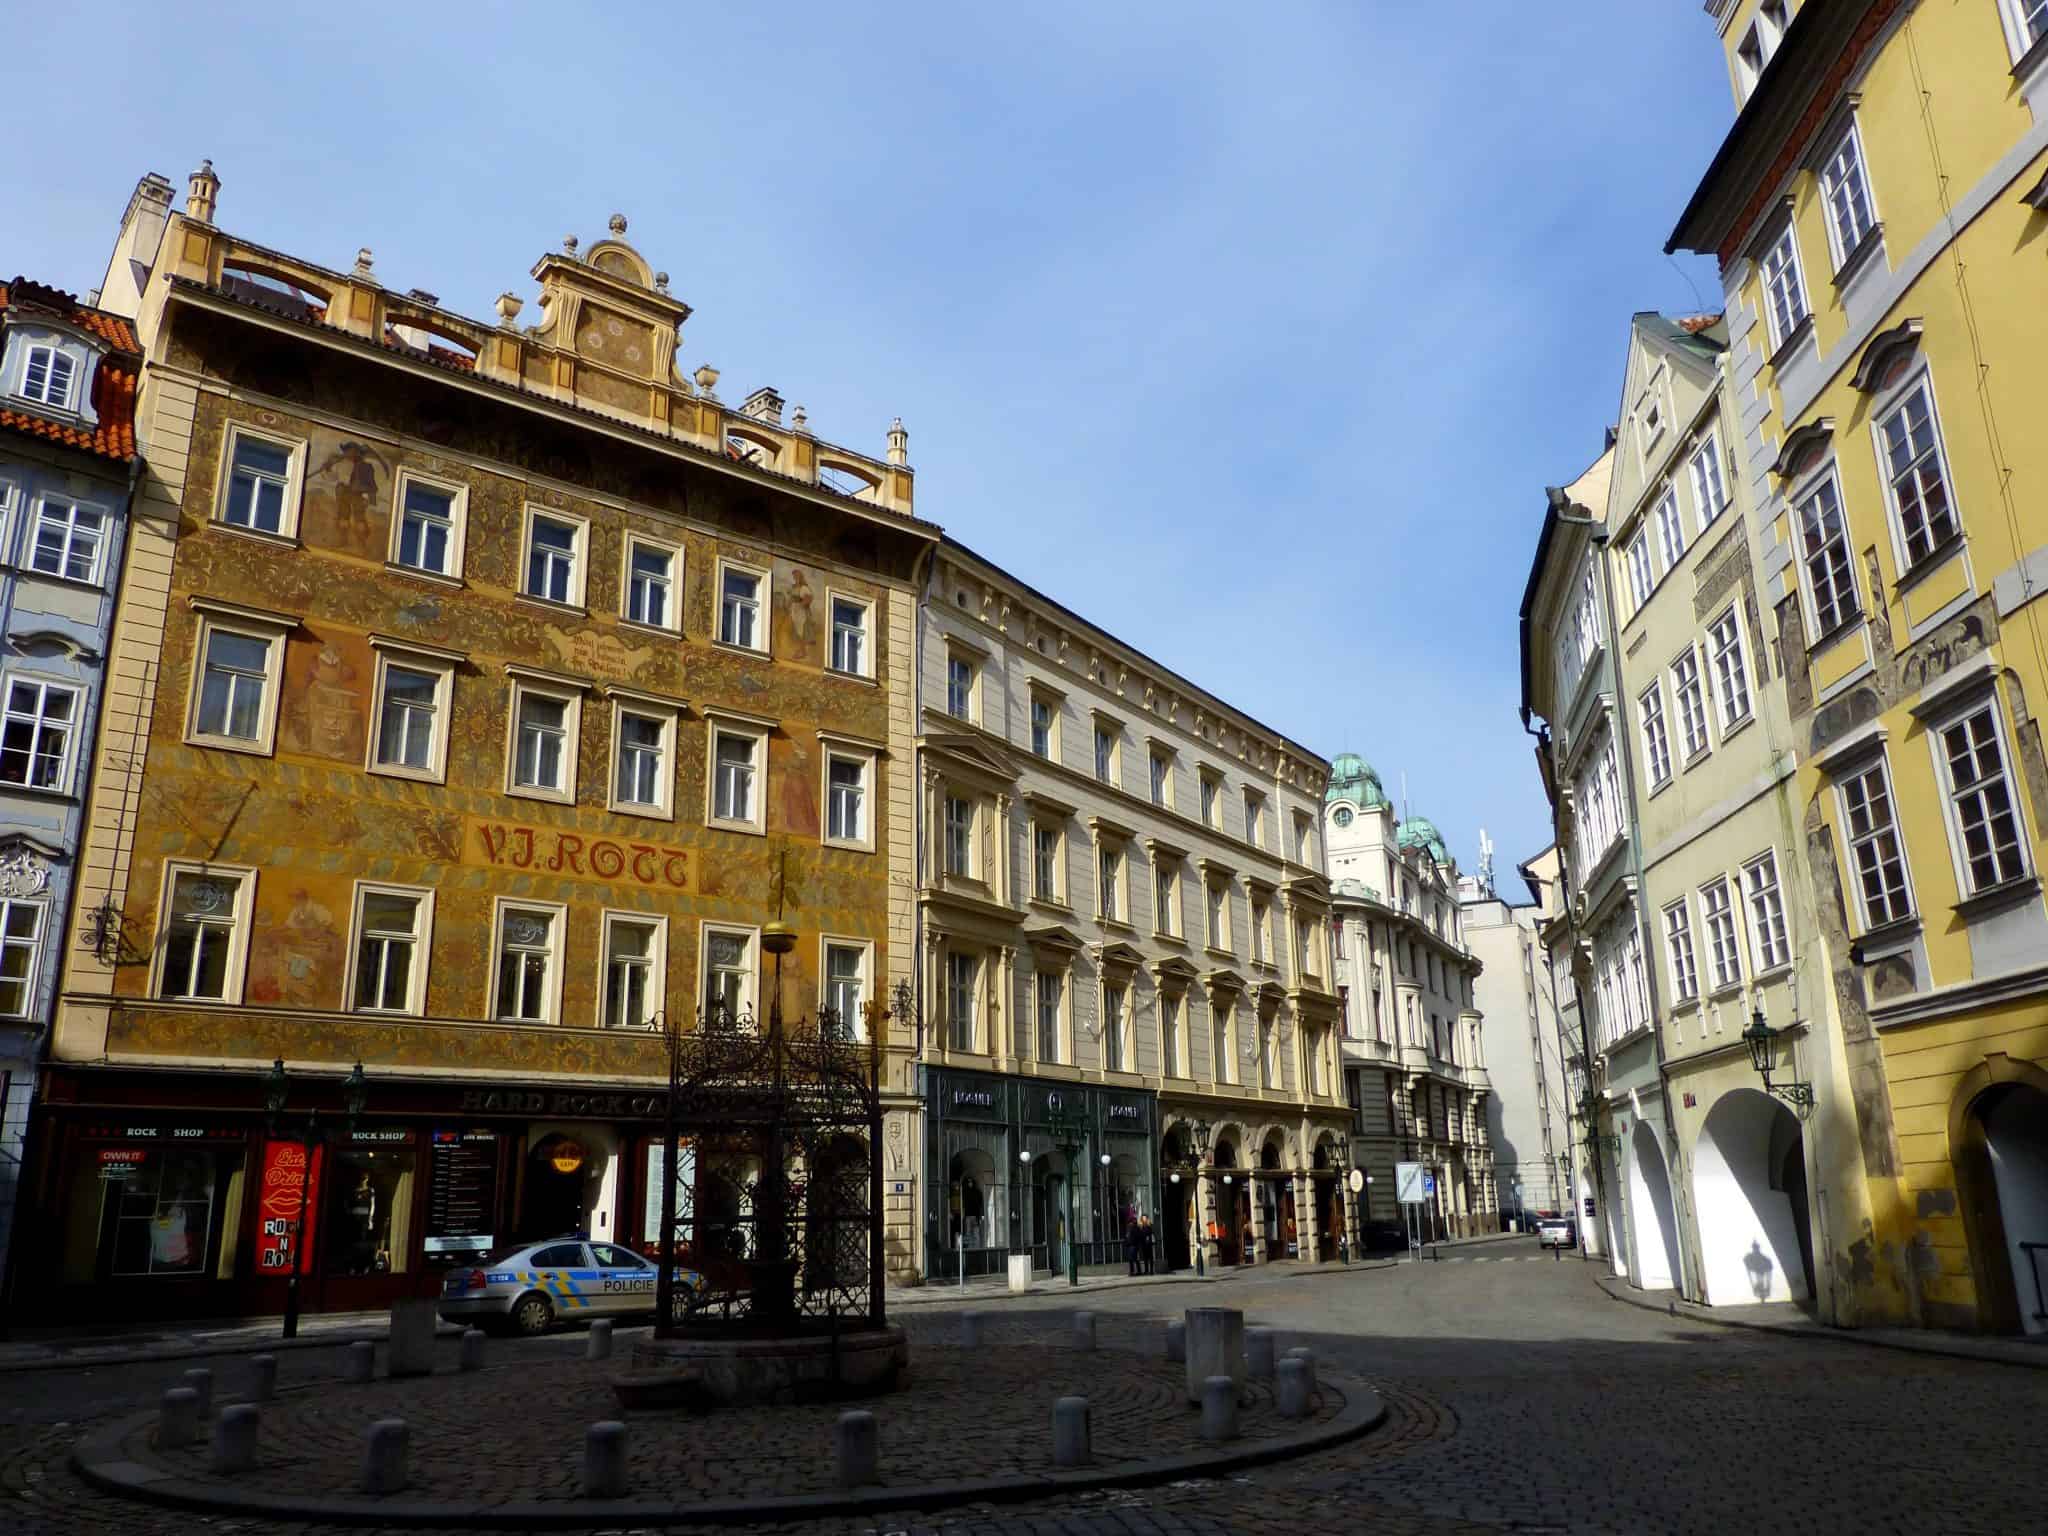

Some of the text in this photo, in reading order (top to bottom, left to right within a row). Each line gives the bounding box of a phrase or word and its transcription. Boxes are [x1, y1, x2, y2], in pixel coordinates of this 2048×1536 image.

[464, 1088, 544, 1113] HARD
[551, 1091, 626, 1115] ROCK
[127, 1127, 204, 1138] ROCK SHOP
[351, 1131, 406, 1141] ROCK SHOP
[103, 1151, 130, 1161] OWN
[603, 1279, 654, 1292] POLICIE
